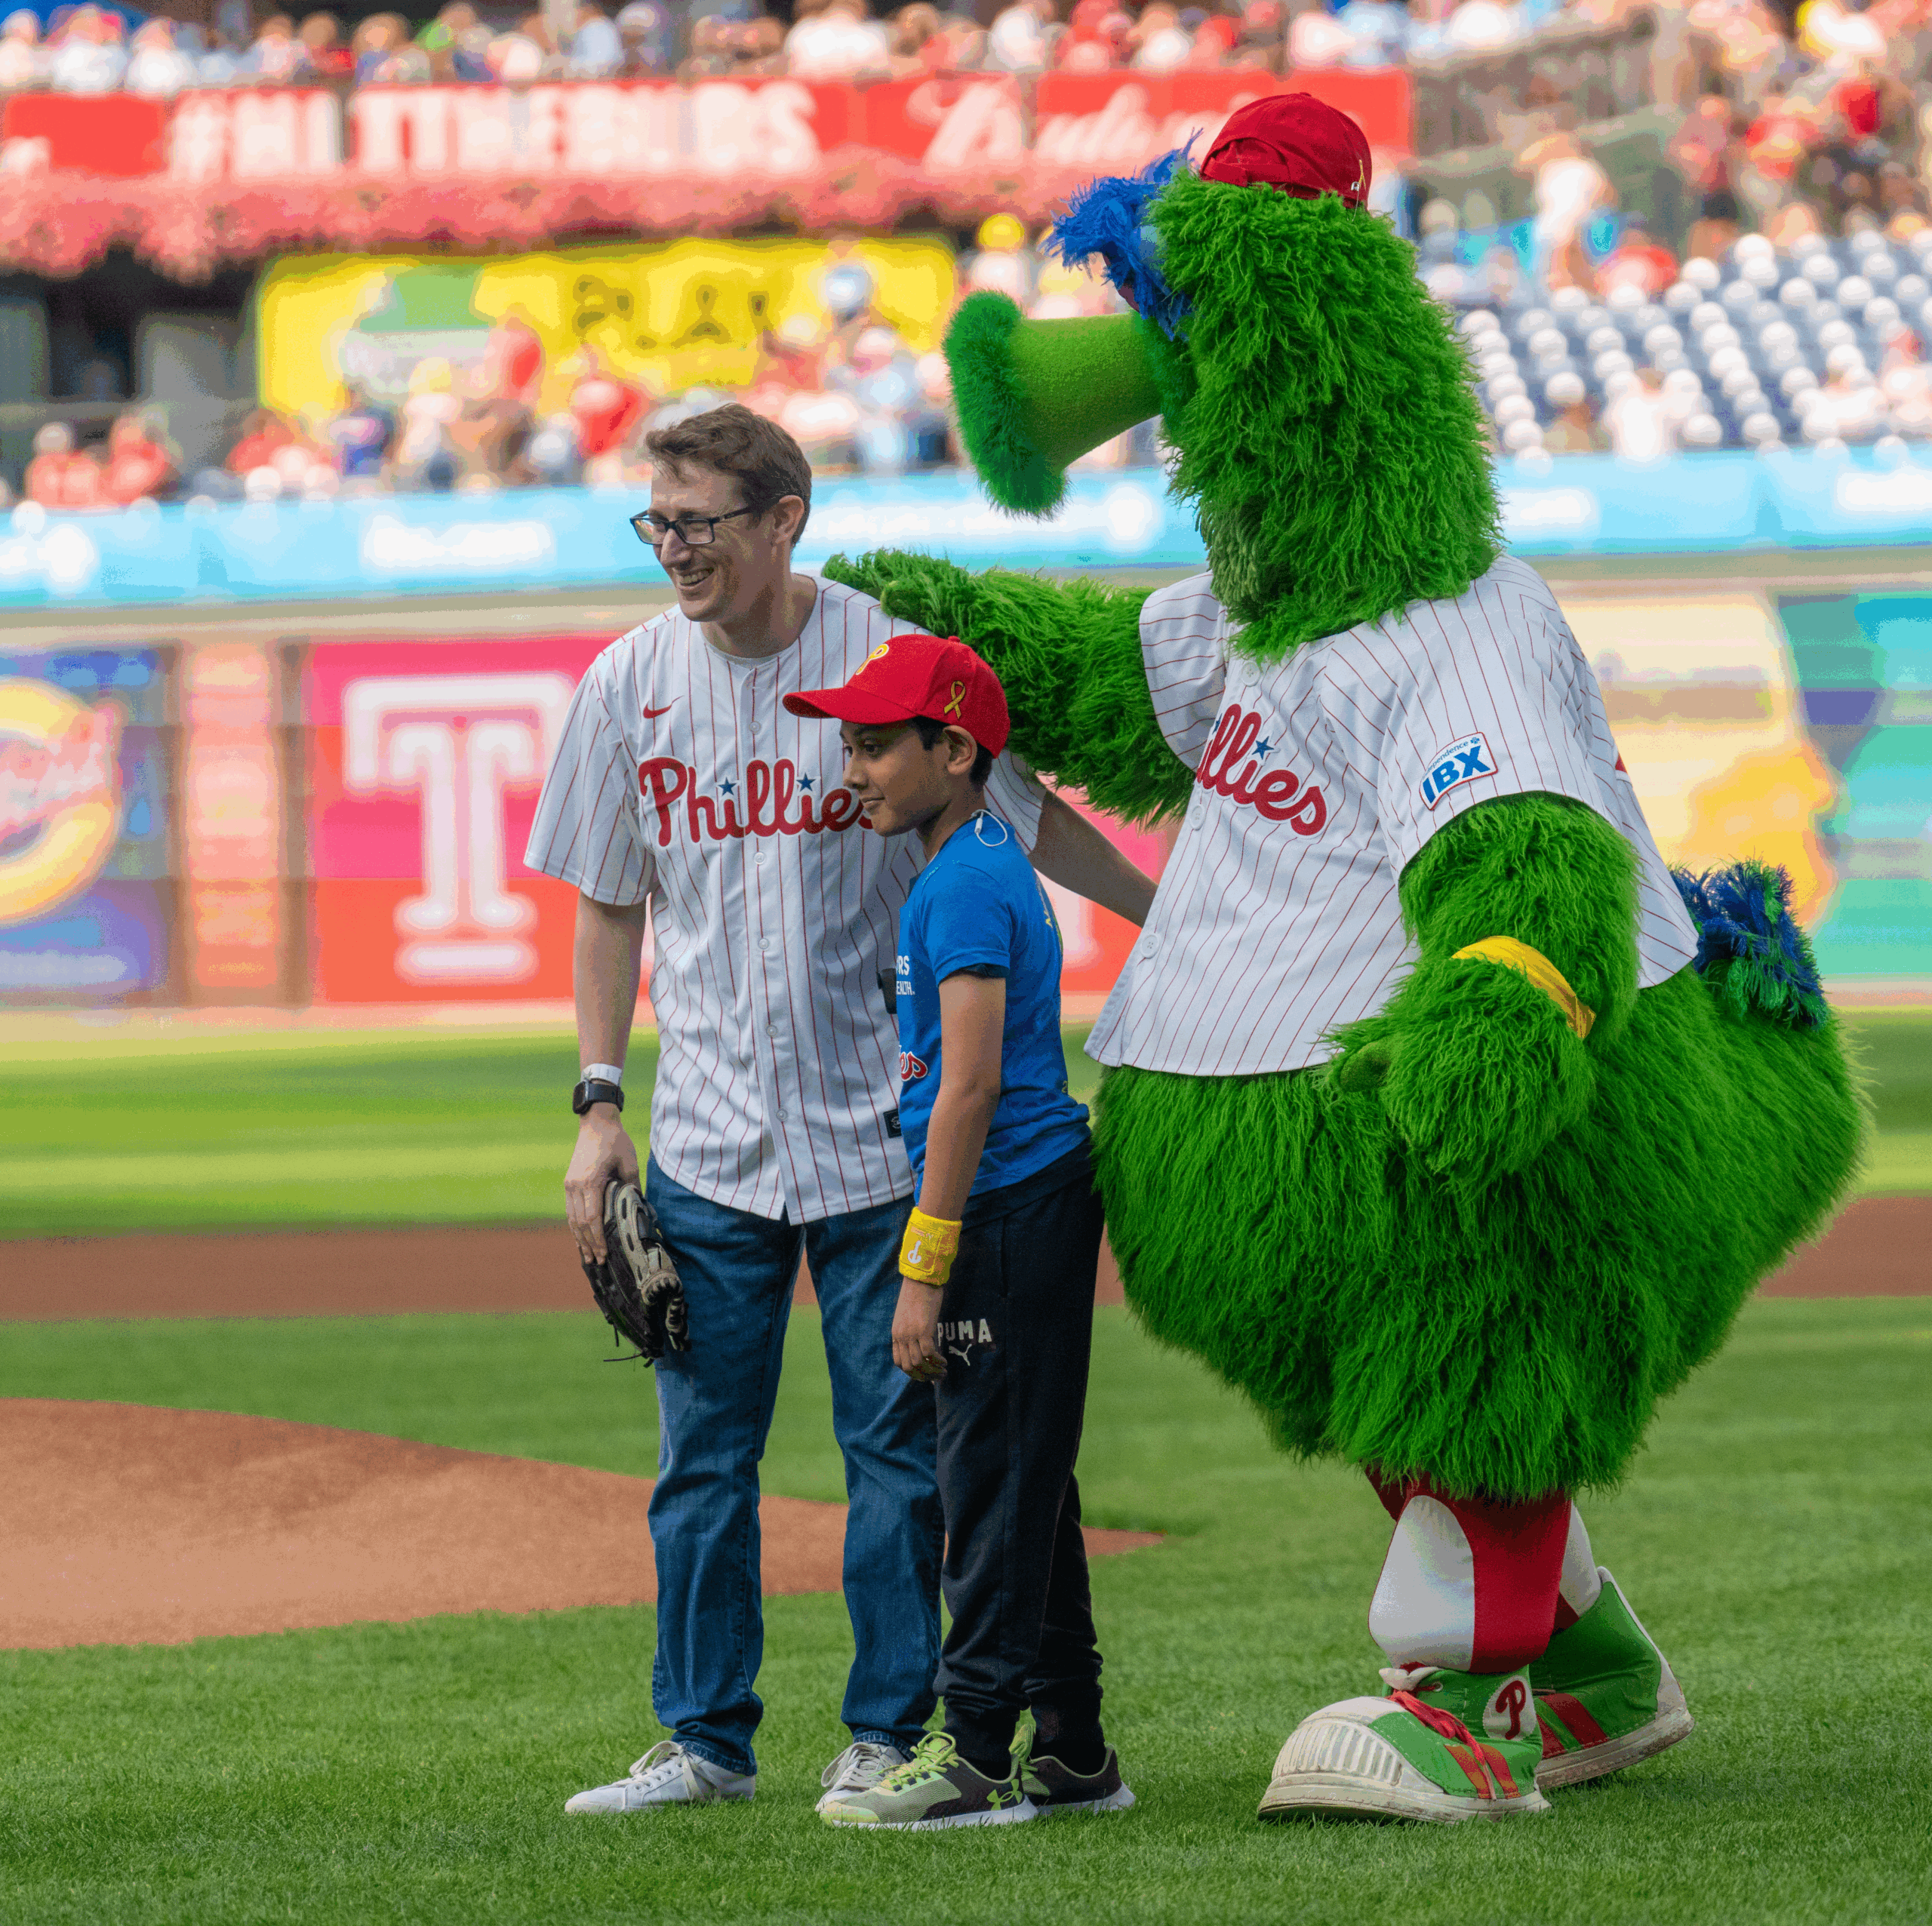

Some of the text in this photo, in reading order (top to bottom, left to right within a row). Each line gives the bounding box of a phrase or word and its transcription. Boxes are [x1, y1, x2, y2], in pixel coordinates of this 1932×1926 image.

[855, 643, 889, 675] P
[1422, 745, 1491, 805] IBX
[896, 955, 911, 977] RS
[937, 1318, 992, 1347] PUMA
[1495, 1680, 1527, 1740] P
